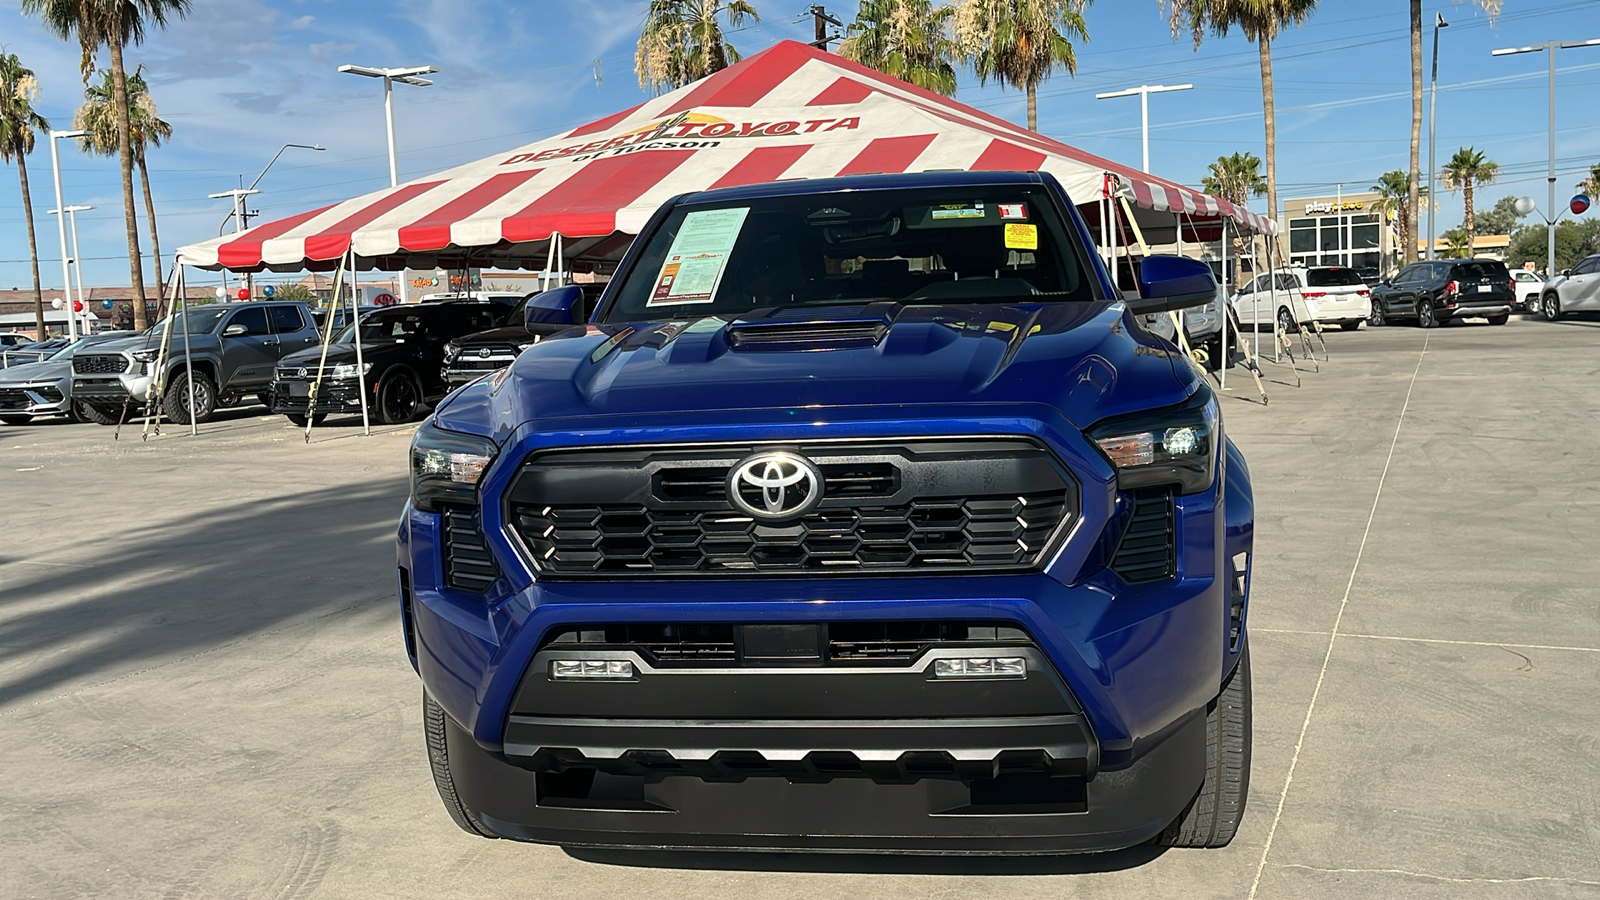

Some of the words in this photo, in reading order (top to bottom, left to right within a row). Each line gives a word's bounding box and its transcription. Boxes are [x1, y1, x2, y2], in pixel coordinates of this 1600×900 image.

[499, 128, 662, 166] DESERT
[674, 116, 861, 137] TOYOTA
[572, 151, 606, 162] of
[613, 141, 721, 155] Tucson
